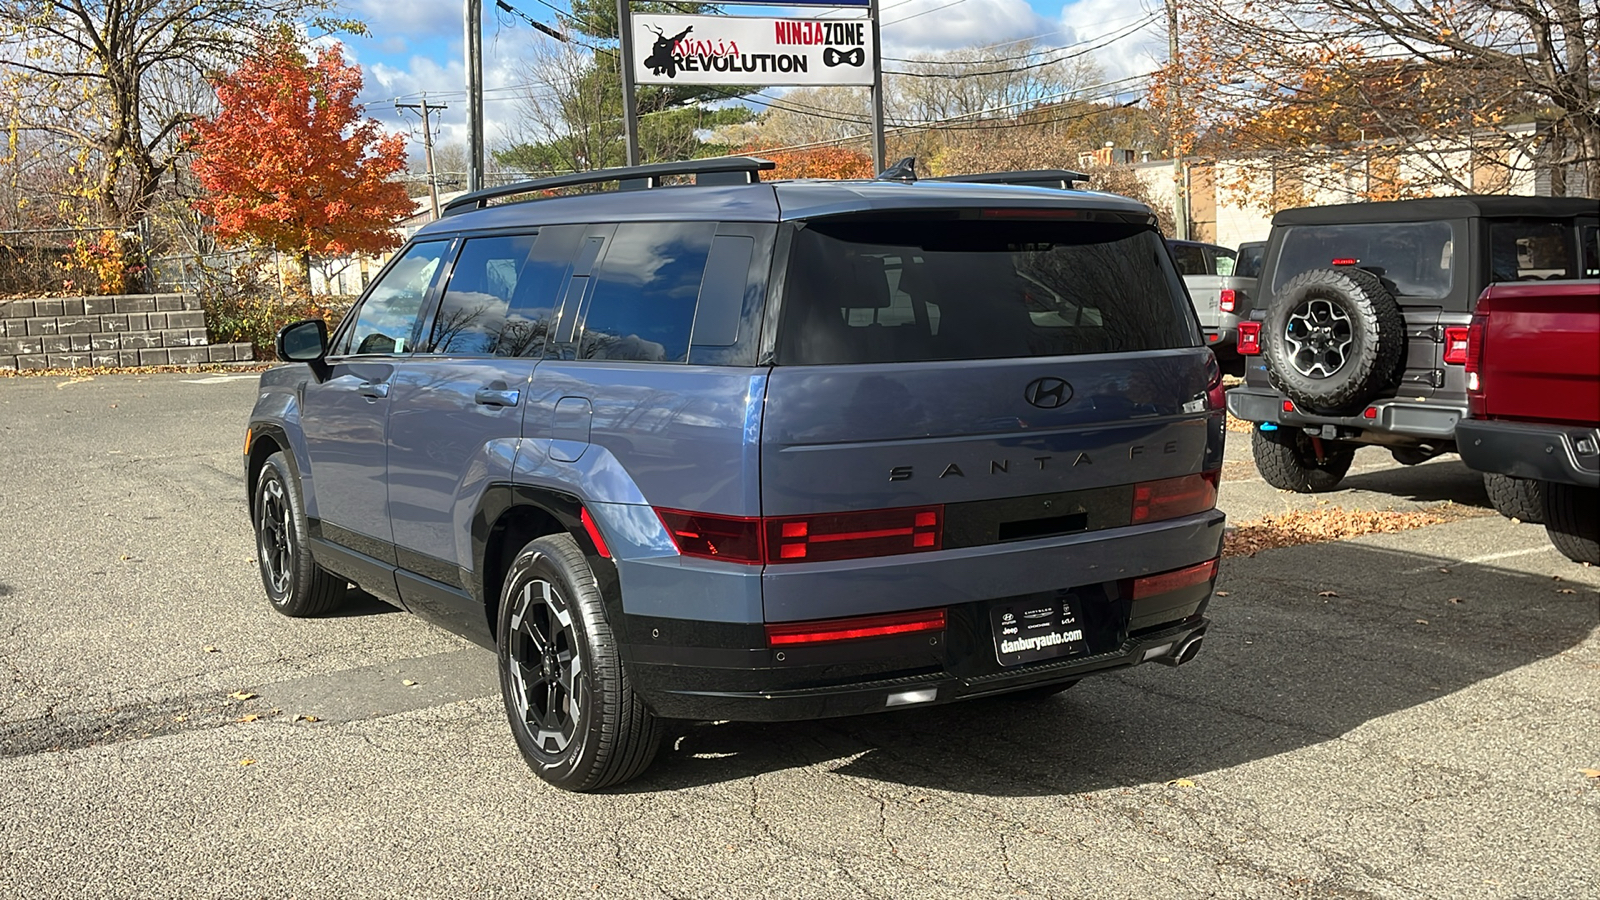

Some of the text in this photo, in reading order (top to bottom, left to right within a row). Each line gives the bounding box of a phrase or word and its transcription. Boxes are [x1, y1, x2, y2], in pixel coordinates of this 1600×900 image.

[775, 21, 865, 46] NINJAZONE
[672, 53, 808, 73] REVOLUTION
[889, 440, 1177, 482] SANTA FE
[1001, 629, 1082, 653] danburyauto.com
[1002, 627, 1018, 635] Jeep
